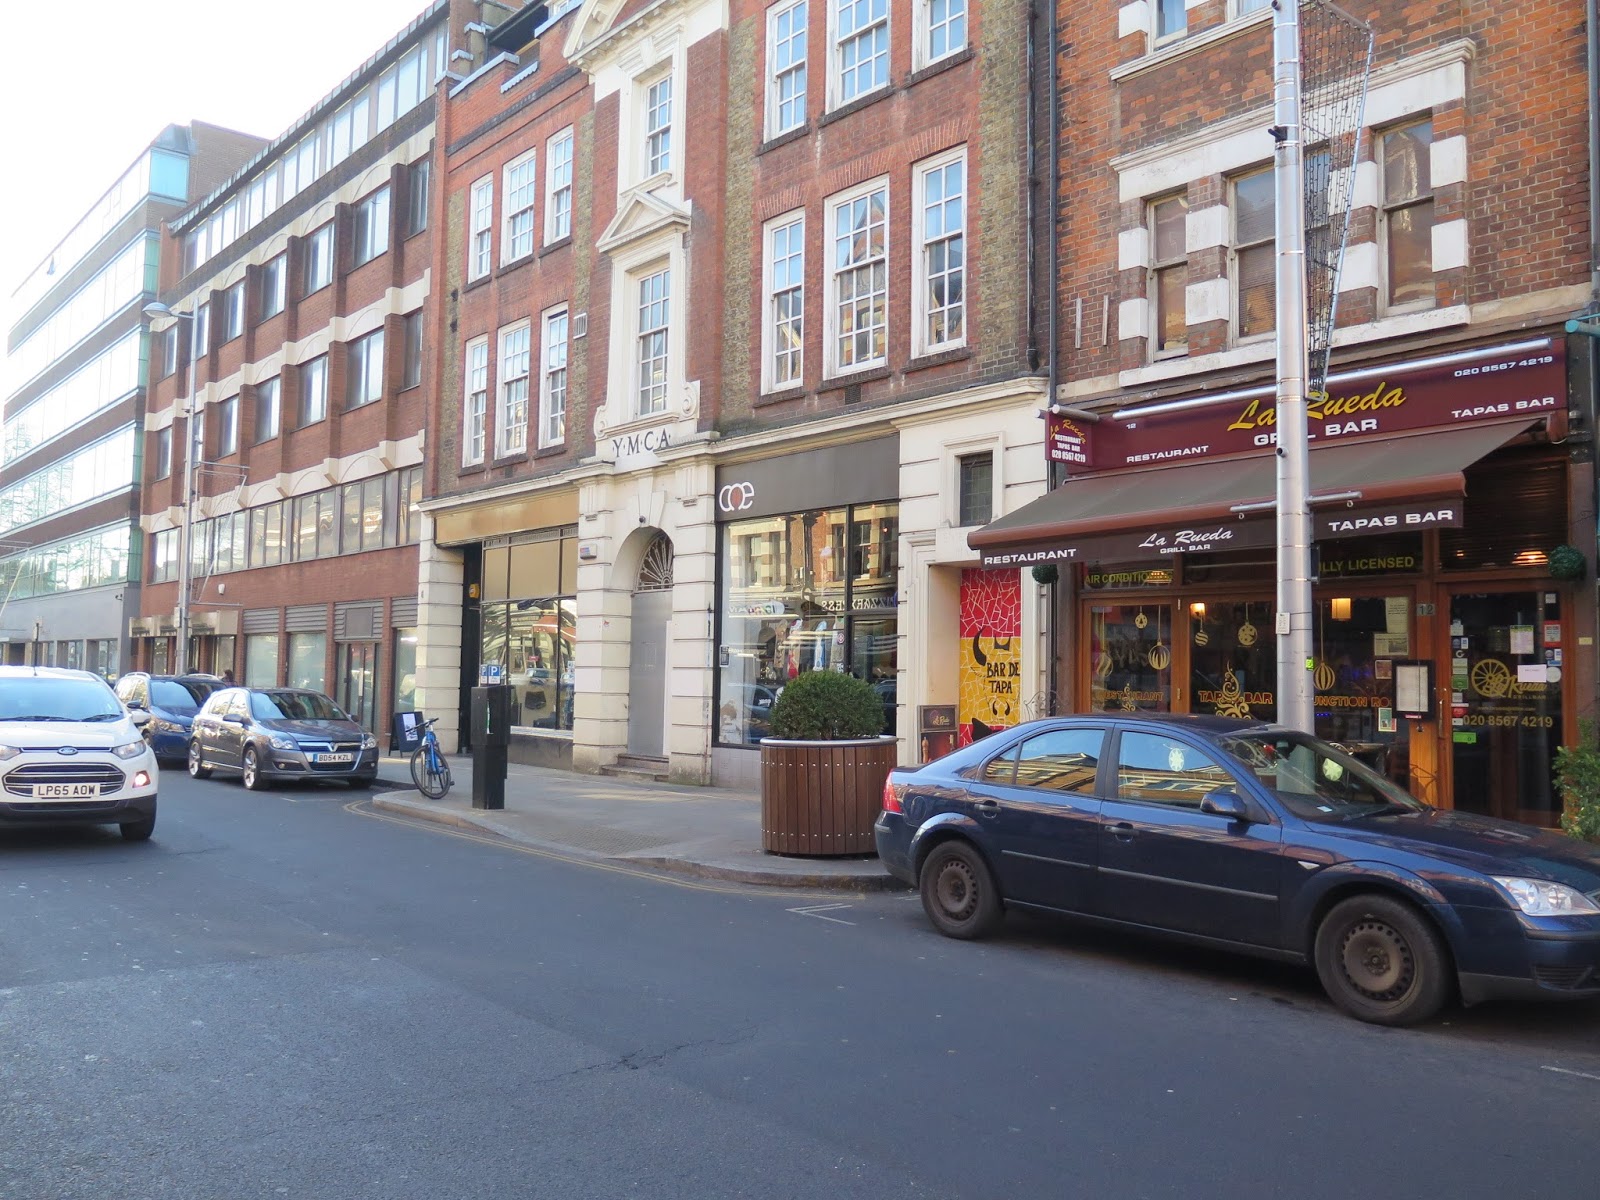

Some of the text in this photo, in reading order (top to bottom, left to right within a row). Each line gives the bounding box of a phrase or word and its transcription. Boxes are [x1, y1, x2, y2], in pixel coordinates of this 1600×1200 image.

[1454, 356, 1553, 377] 020 8567 4219
[1227, 399, 1277, 432] La
[1451, 397, 1555, 418] TAPAS BAR
[1325, 418, 1378, 437] BAR
[1051, 449, 1062, 459] 020
[1126, 445, 1209, 463] RESTAURANT
[1328, 510, 1453, 532] TAPAS BAR
[1138, 527, 1234, 548] La Rueda
[984, 549, 1077, 565] RESTAURANT
[1159, 544, 1211, 555] GRILL BAR
[1319, 556, 1415, 572] LLY LICENSED
[1085, 574, 1100, 584] AIR
[1419, 603, 1434, 615] 12
[986, 661, 1020, 678] BAR DE
[988, 680, 1013, 694] TAPA
[1244, 691, 1273, 705] BAR
[1463, 715, 1553, 728] 020 8567 4219
[37, 785, 95, 796] LP65 AOW
